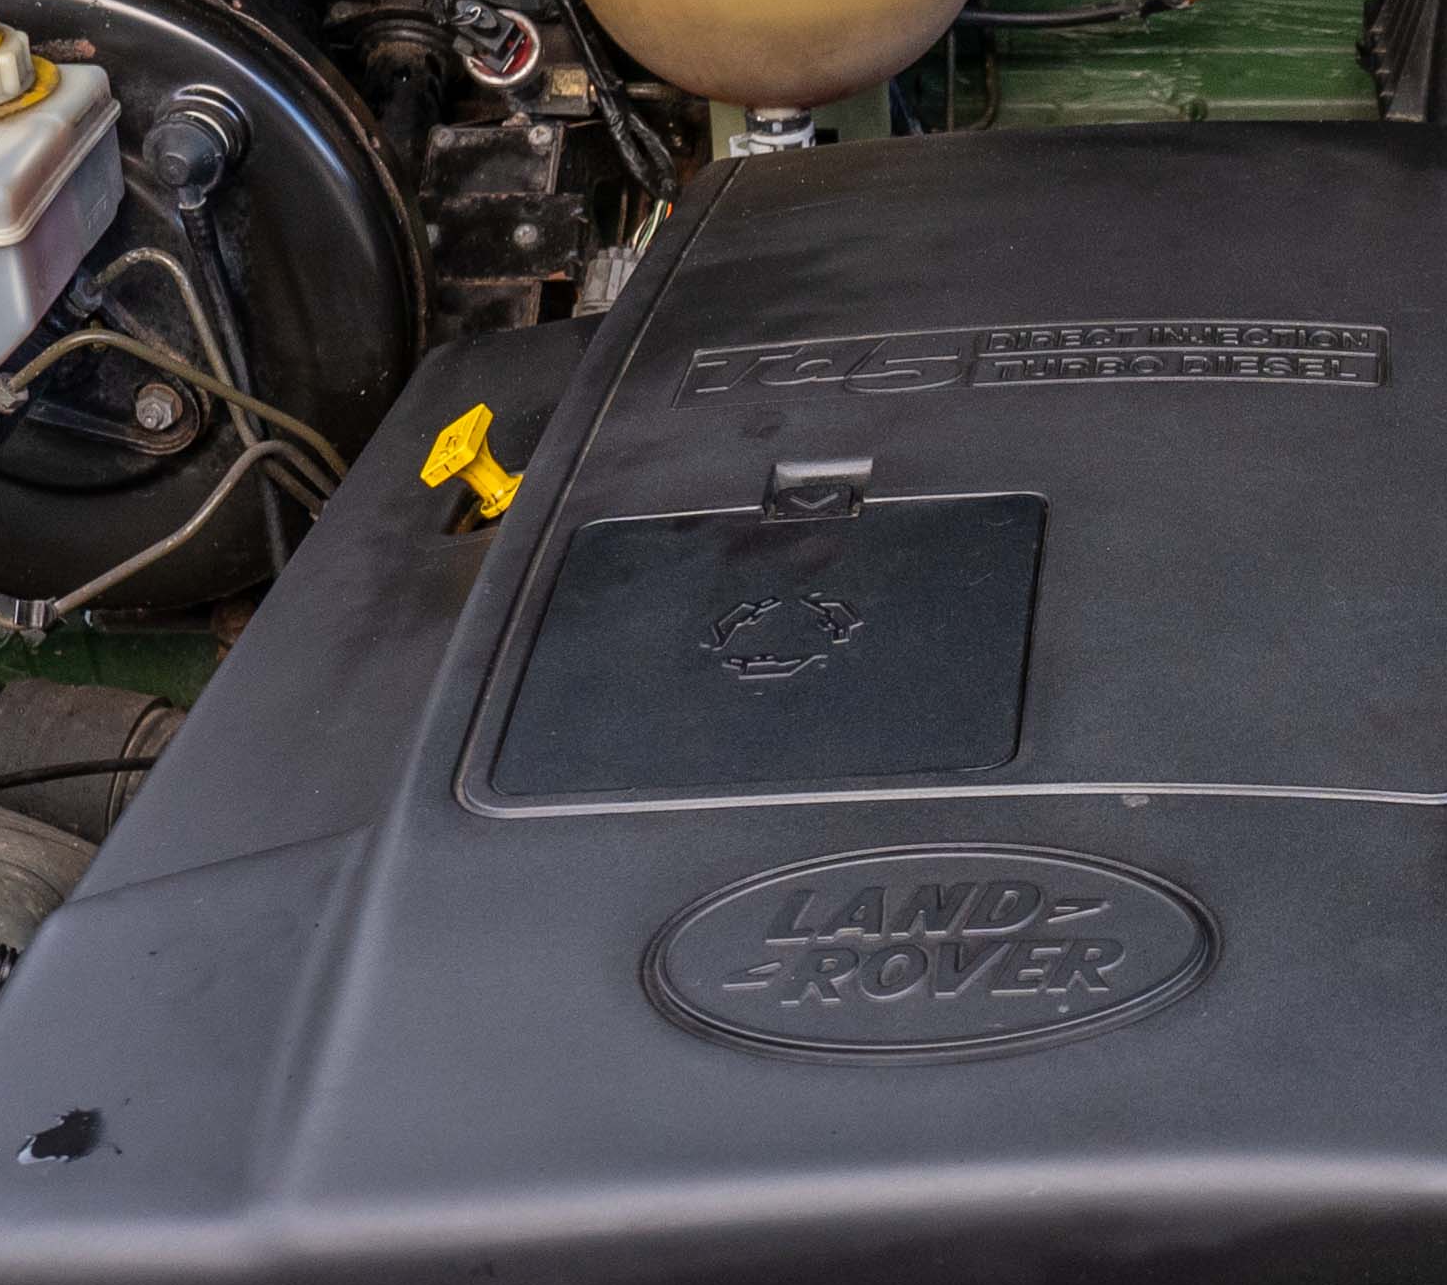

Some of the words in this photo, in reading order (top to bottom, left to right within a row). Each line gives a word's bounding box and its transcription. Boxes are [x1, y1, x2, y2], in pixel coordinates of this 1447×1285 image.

[987, 326, 1140, 351] DIRECT
[1149, 326, 1371, 351] INJECTION
[695, 341, 959, 394] Td5
[993, 355, 1167, 378] TURBO
[1181, 354, 1358, 377] DIESEL
